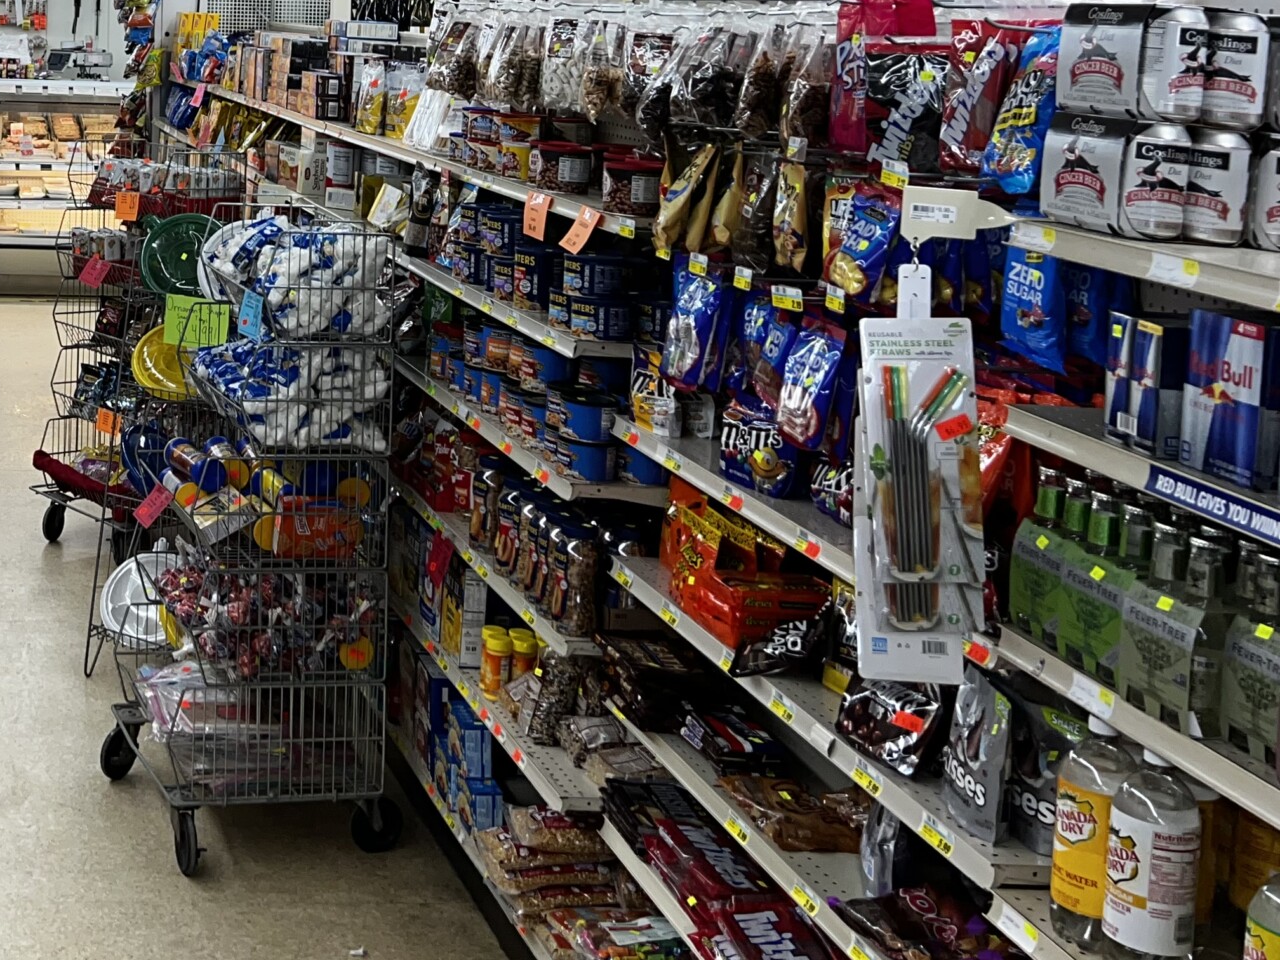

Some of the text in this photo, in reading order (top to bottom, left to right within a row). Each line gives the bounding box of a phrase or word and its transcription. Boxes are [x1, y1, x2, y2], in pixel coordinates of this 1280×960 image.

[1074, 60, 1118, 78] GINGER BEER
[1227, 83, 1253, 96] BEER
[1141, 144, 1190, 162] Gosling
[1059, 171, 1101, 190] GINGER BEER
[1130, 190, 1170, 202] GINGER
[1197, 196, 1223, 211] BEER
[1008, 260, 1045, 290] ZERO
[1006, 280, 1042, 306] SUGAR
[869, 348, 911, 356] STRAWS
[1190, 350, 1253, 389] Red Bull
[1156, 474, 1251, 526] RED BULL GIVES YOU
[1066, 568, 1120, 604] FEVER-TREE
[1129, 606, 1188, 643] FEVER-TREE
[1231, 642, 1280, 670] FEVER-TR
[1051, 712, 1082, 736] SHARE
[1061, 820, 1084, 836] DRY
[1154, 832, 1195, 843] Nutrition
[1066, 870, 1098, 889] WATER
